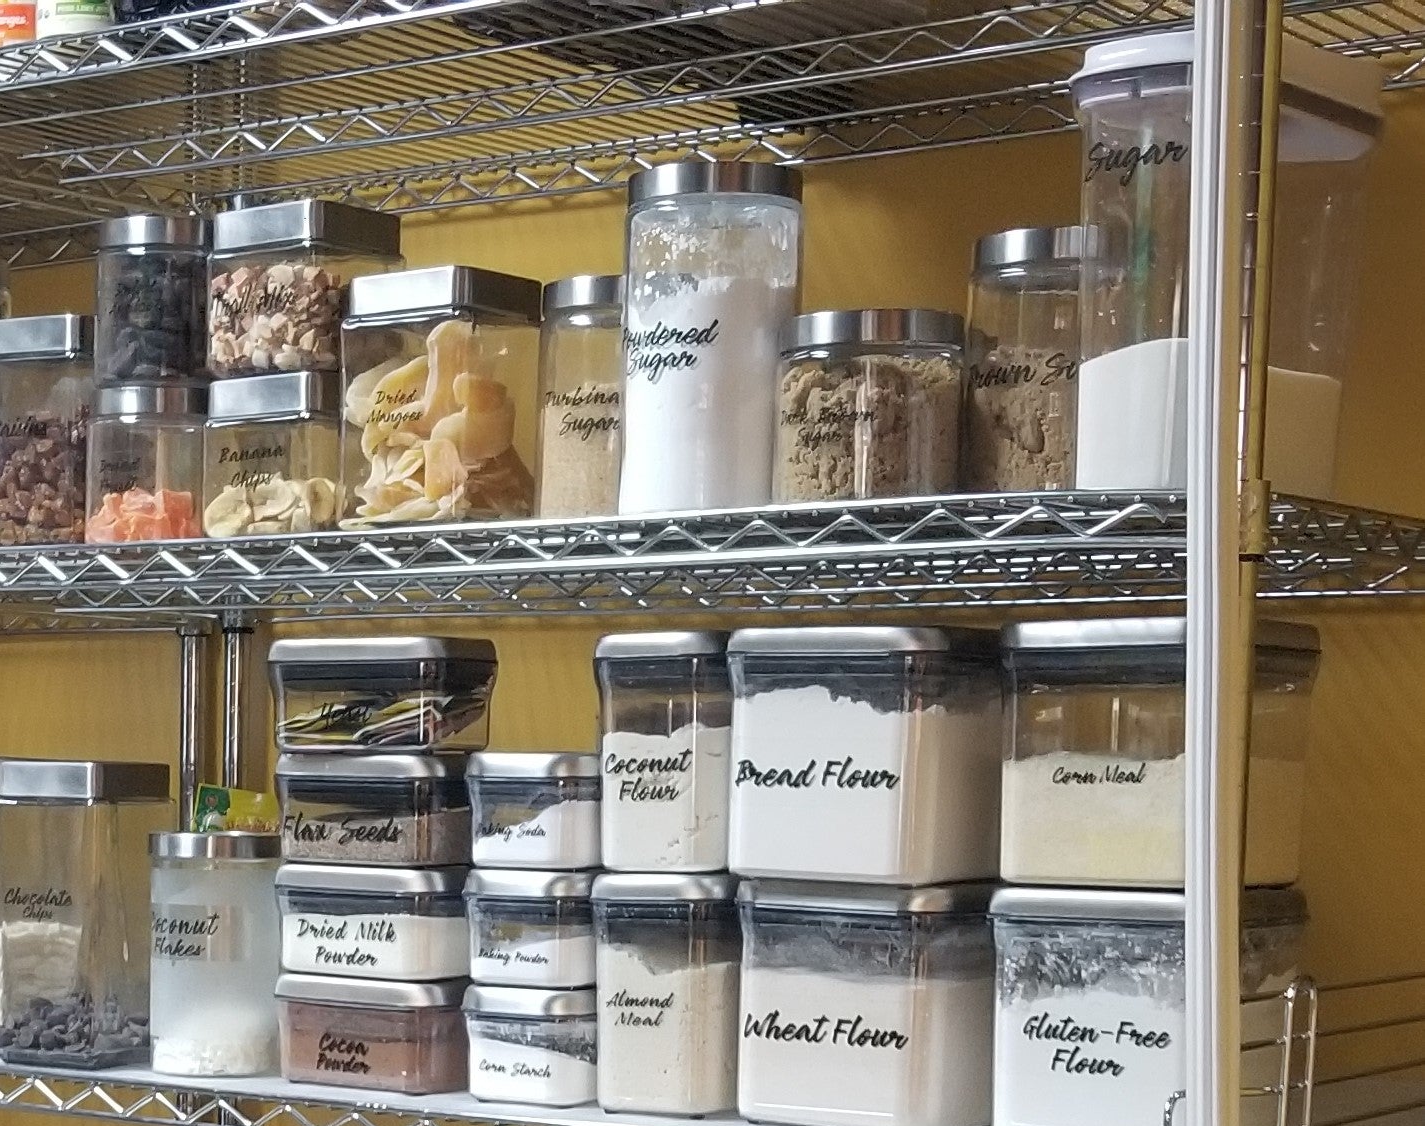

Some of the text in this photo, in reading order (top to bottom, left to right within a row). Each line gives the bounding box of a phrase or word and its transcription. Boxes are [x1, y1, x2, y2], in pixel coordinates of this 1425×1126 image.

[1084, 140, 1188, 187] Sugar
[627, 349, 700, 383] Sugar
[375, 389, 417, 406] Dried
[545, 387, 620, 409] Turbina
[218, 446, 286, 464] Banana
[231, 471, 275, 492] Chips
[604, 749, 693, 775] Coconut
[1052, 761, 1147, 785] Corn Meal
[736, 757, 901, 792] Bread Flour
[619, 779, 680, 803] Flour
[338, 815, 403, 846] Seeds
[516, 822, 546, 839] Soda
[4, 887, 73, 906] Chocolate
[297, 917, 397, 943] Dried Milk
[154, 936, 206, 967] Flakes
[315, 943, 379, 967] Powder
[514, 949, 549, 965] Powder
[606, 991, 675, 1010] Almond
[614, 1010, 664, 1028] Meal
[742, 1011, 909, 1051] Wheat Flour
[1022, 1011, 1171, 1050] Gluten-Free
[317, 1030, 370, 1058] Cocoa
[315, 1052, 371, 1076] Powder
[478, 1057, 553, 1080] Corn Starch
[1050, 1046, 1126, 1078] Flour
